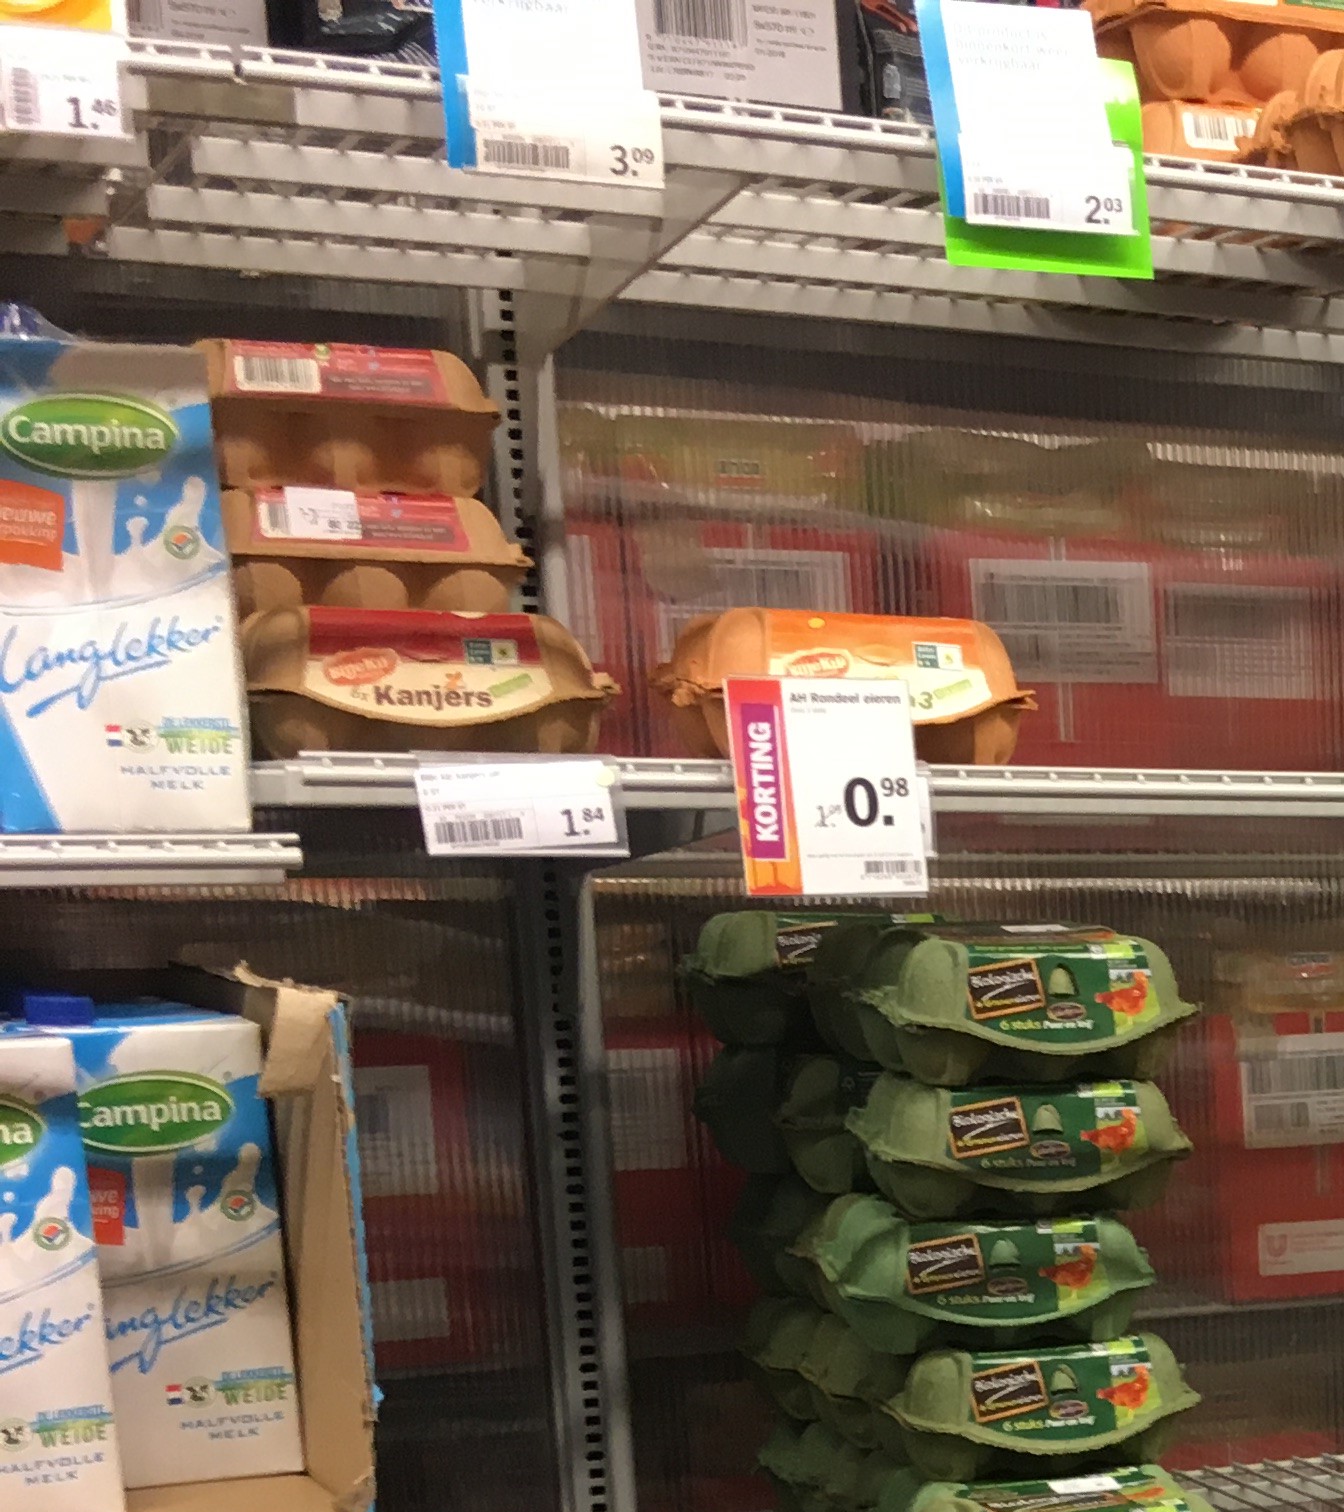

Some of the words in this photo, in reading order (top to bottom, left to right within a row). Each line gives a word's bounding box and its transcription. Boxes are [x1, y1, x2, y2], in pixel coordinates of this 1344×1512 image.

[608, 143, 655, 178] 3.09
[1085, 195, 1123, 224] 2.03
[8, 414, 167, 456] Campina
[374, 685, 493, 711] Kanjers
[811, 692, 860, 705] Rondeel
[864, 694, 902, 706] eieren
[165, 737, 234, 755] WEIDE
[121, 765, 231, 777] HALFVOLLE
[746, 720, 779, 842] KORTING
[150, 779, 205, 791] MELK
[844, 777, 910, 828] 0.98
[560, 808, 605, 837] 1.84
[1013, 1019, 1042, 1030] stuks
[225, 1382, 288, 1406] WEIDE
[180, 1411, 285, 1430] HALFVOLLE
[43, 1424, 108, 1447] WEIDE
[209, 1425, 260, 1440] MELK
[25, 1470, 78, 1486] MELK
